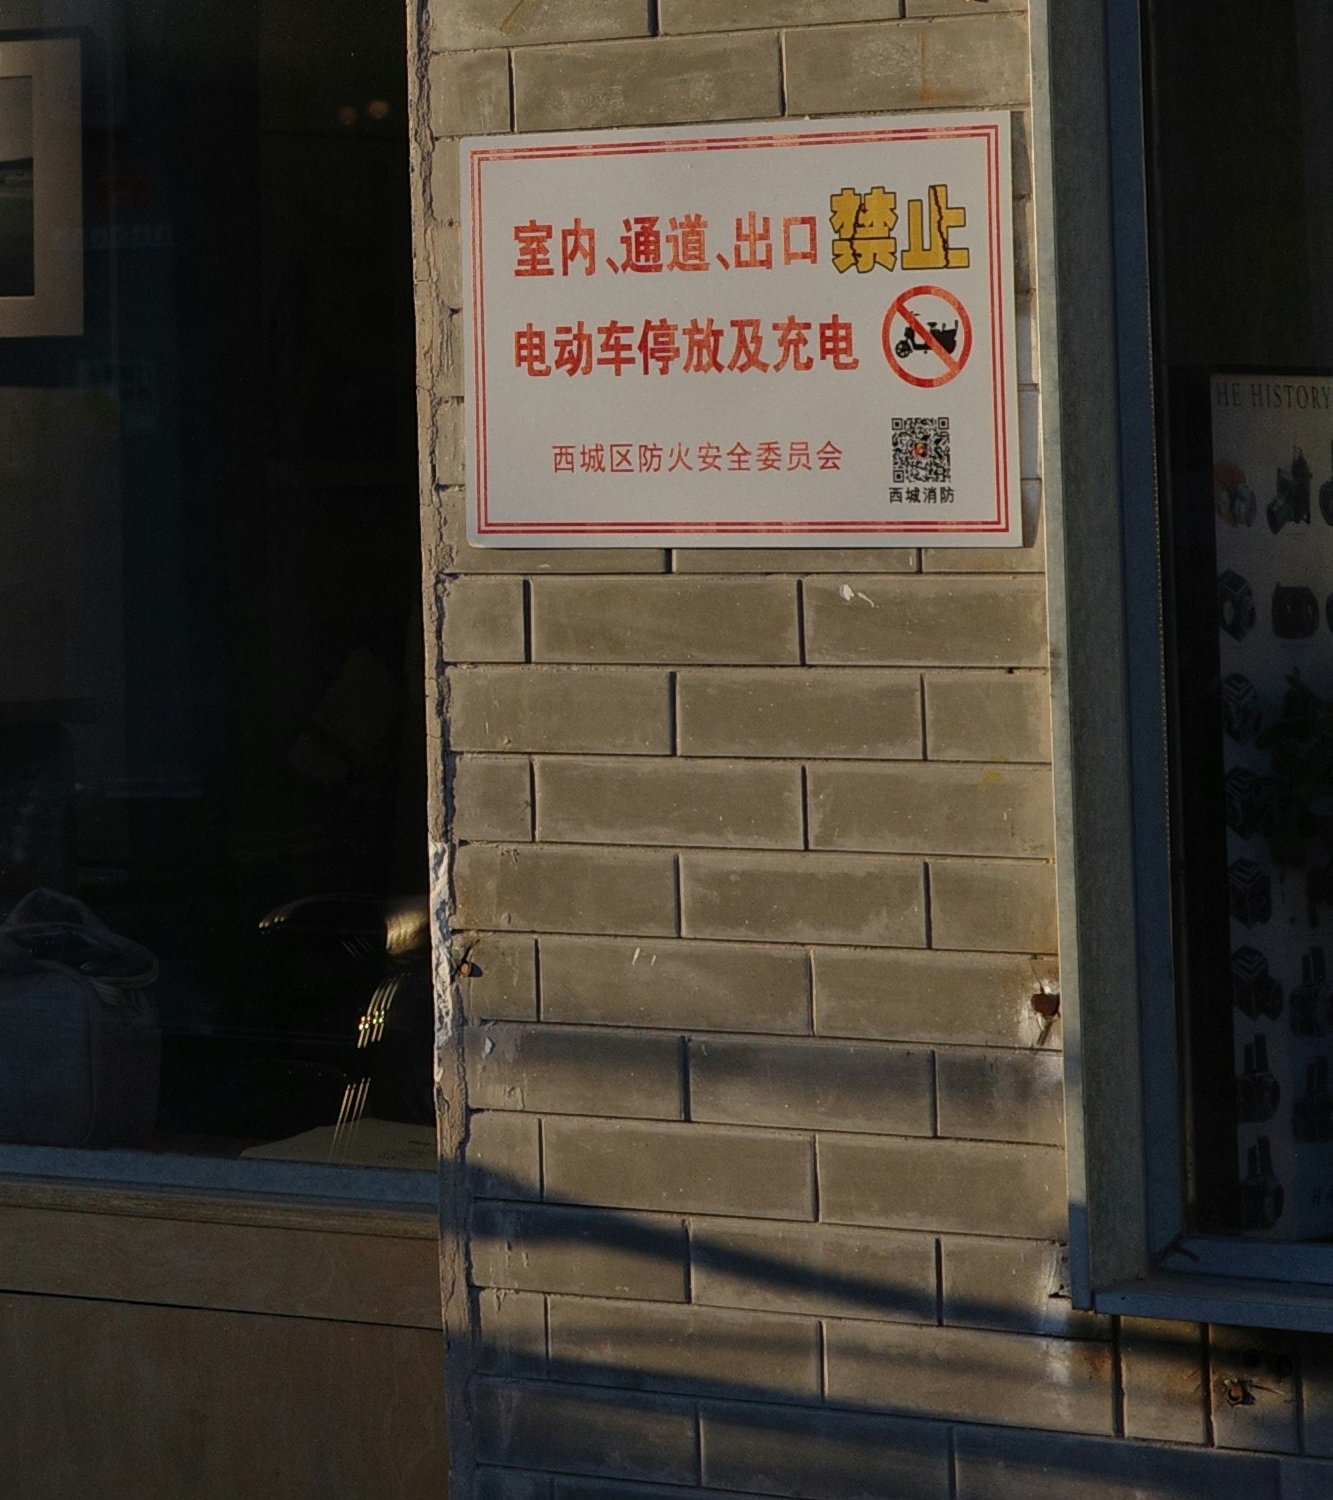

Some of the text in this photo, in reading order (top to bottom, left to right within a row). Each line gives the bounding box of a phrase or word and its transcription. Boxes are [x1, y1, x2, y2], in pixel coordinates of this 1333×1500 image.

[514, 314, 860, 377] 电动车停放及充电
[1251, 383, 1331, 410] HISTORY
[551, 440, 844, 474] 西城区防火安全委员会
[888, 486, 955, 504] 西城消防
